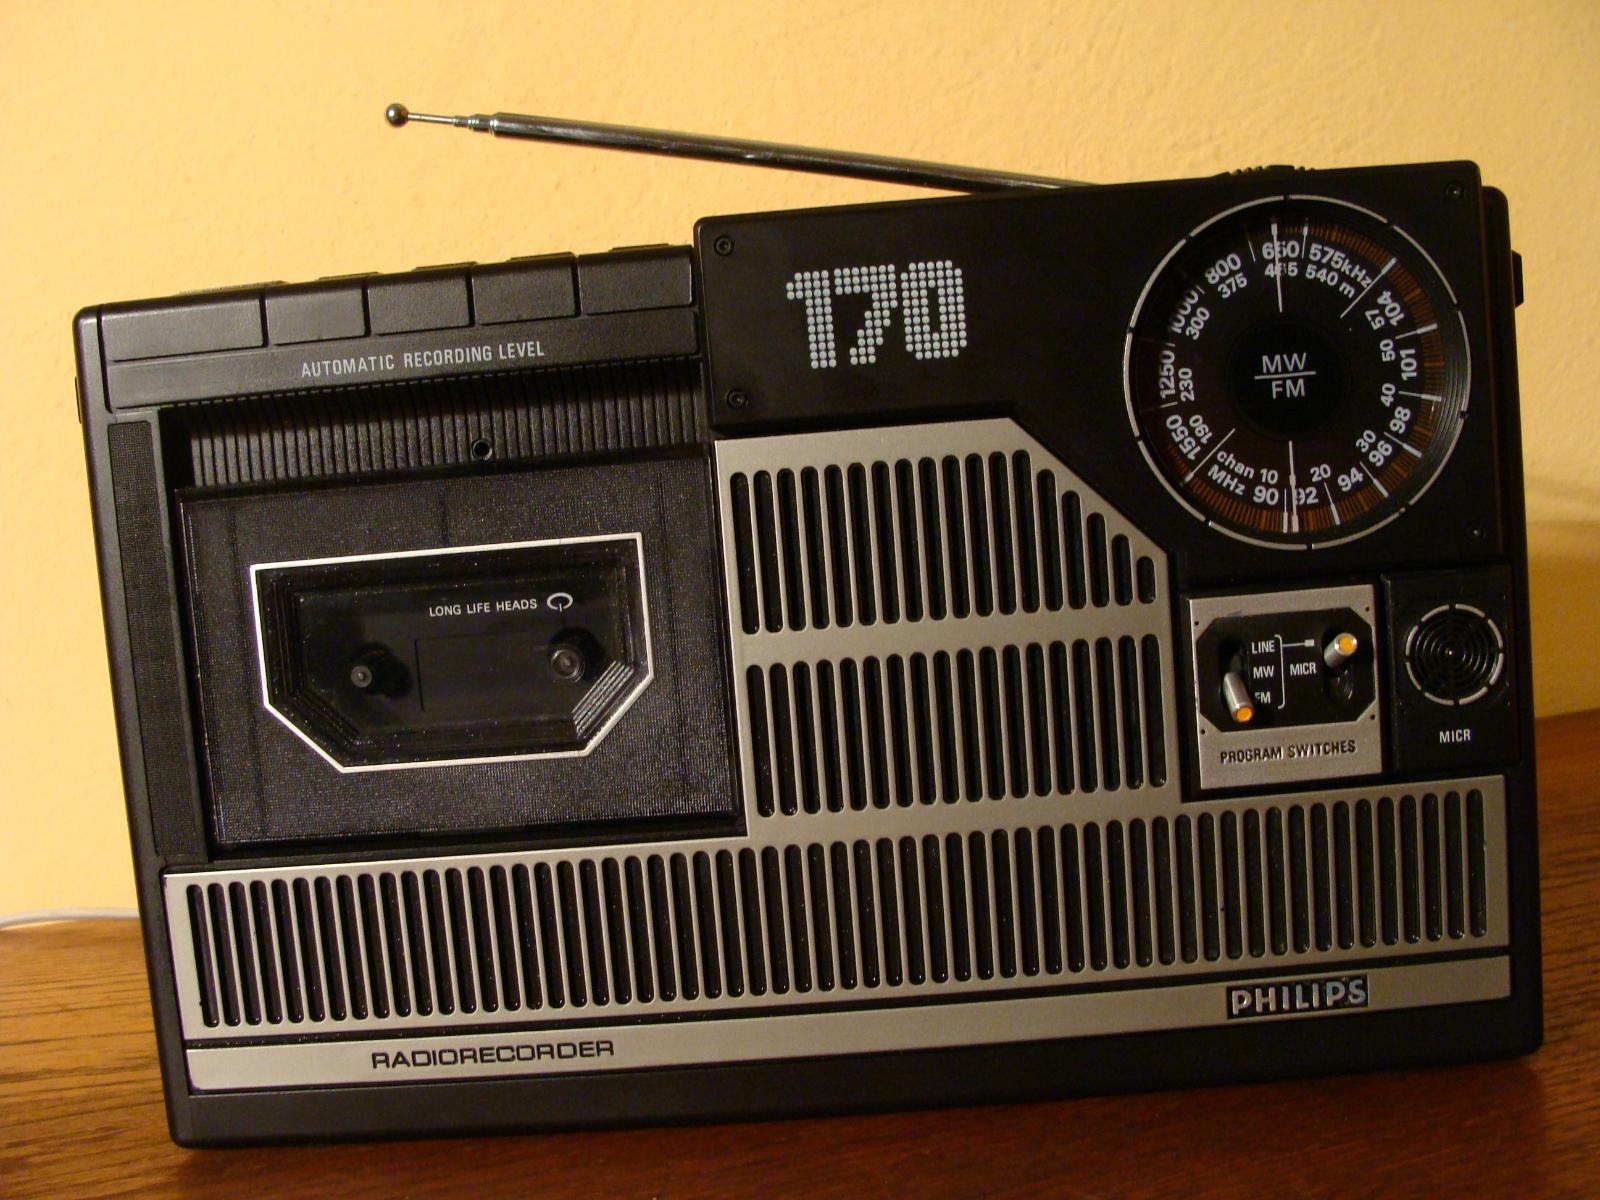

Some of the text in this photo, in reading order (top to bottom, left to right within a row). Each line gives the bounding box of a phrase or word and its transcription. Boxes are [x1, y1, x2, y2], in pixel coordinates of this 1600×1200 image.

[1205, 253, 1242, 285] 800
[1265, 262, 1298, 278] 45
[1305, 264, 1355, 298] 540 m
[1217, 272, 1248, 299] 375
[786, 260, 967, 369] 170
[1364, 309, 1385, 331] 57
[1377, 290, 1405, 327] 104
[1185, 306, 1210, 340] 300
[301, 341, 545, 378] AUTOMATIC RECORDING LEVEL
[1262, 352, 1307, 374] MW
[1380, 339, 1396, 362] 50
[1160, 350, 1176, 399] 1250
[1400, 348, 1418, 381] 101
[1178, 367, 1195, 402] 230
[1272, 378, 1305, 400] FM
[1381, 383, 1396, 407] 40
[1189, 414, 1213, 444] 190
[1389, 406, 1411, 434] 98
[1166, 414, 1201, 460] 1550
[1356, 430, 1376, 453] 30
[1368, 440, 1393, 467] 96
[1216, 450, 1279, 485] chan 10
[1310, 463, 1331, 482] 20
[1337, 467, 1363, 492] 94
[1207, 463, 1279, 505] MHz 90
[429, 599, 538, 617] LONG LIFE HEADS
[1251, 640, 1276, 654] LINE
[1253, 665, 1275, 679] MW
[1289, 662, 1317, 676] MICR
[1440, 728, 1471, 743] MICR
[1220, 740, 1357, 764] PROGRAM SWITCHES
[1232, 979, 1367, 1016] PHILIPS
[371, 1040, 615, 1069] RADIORECORDER
